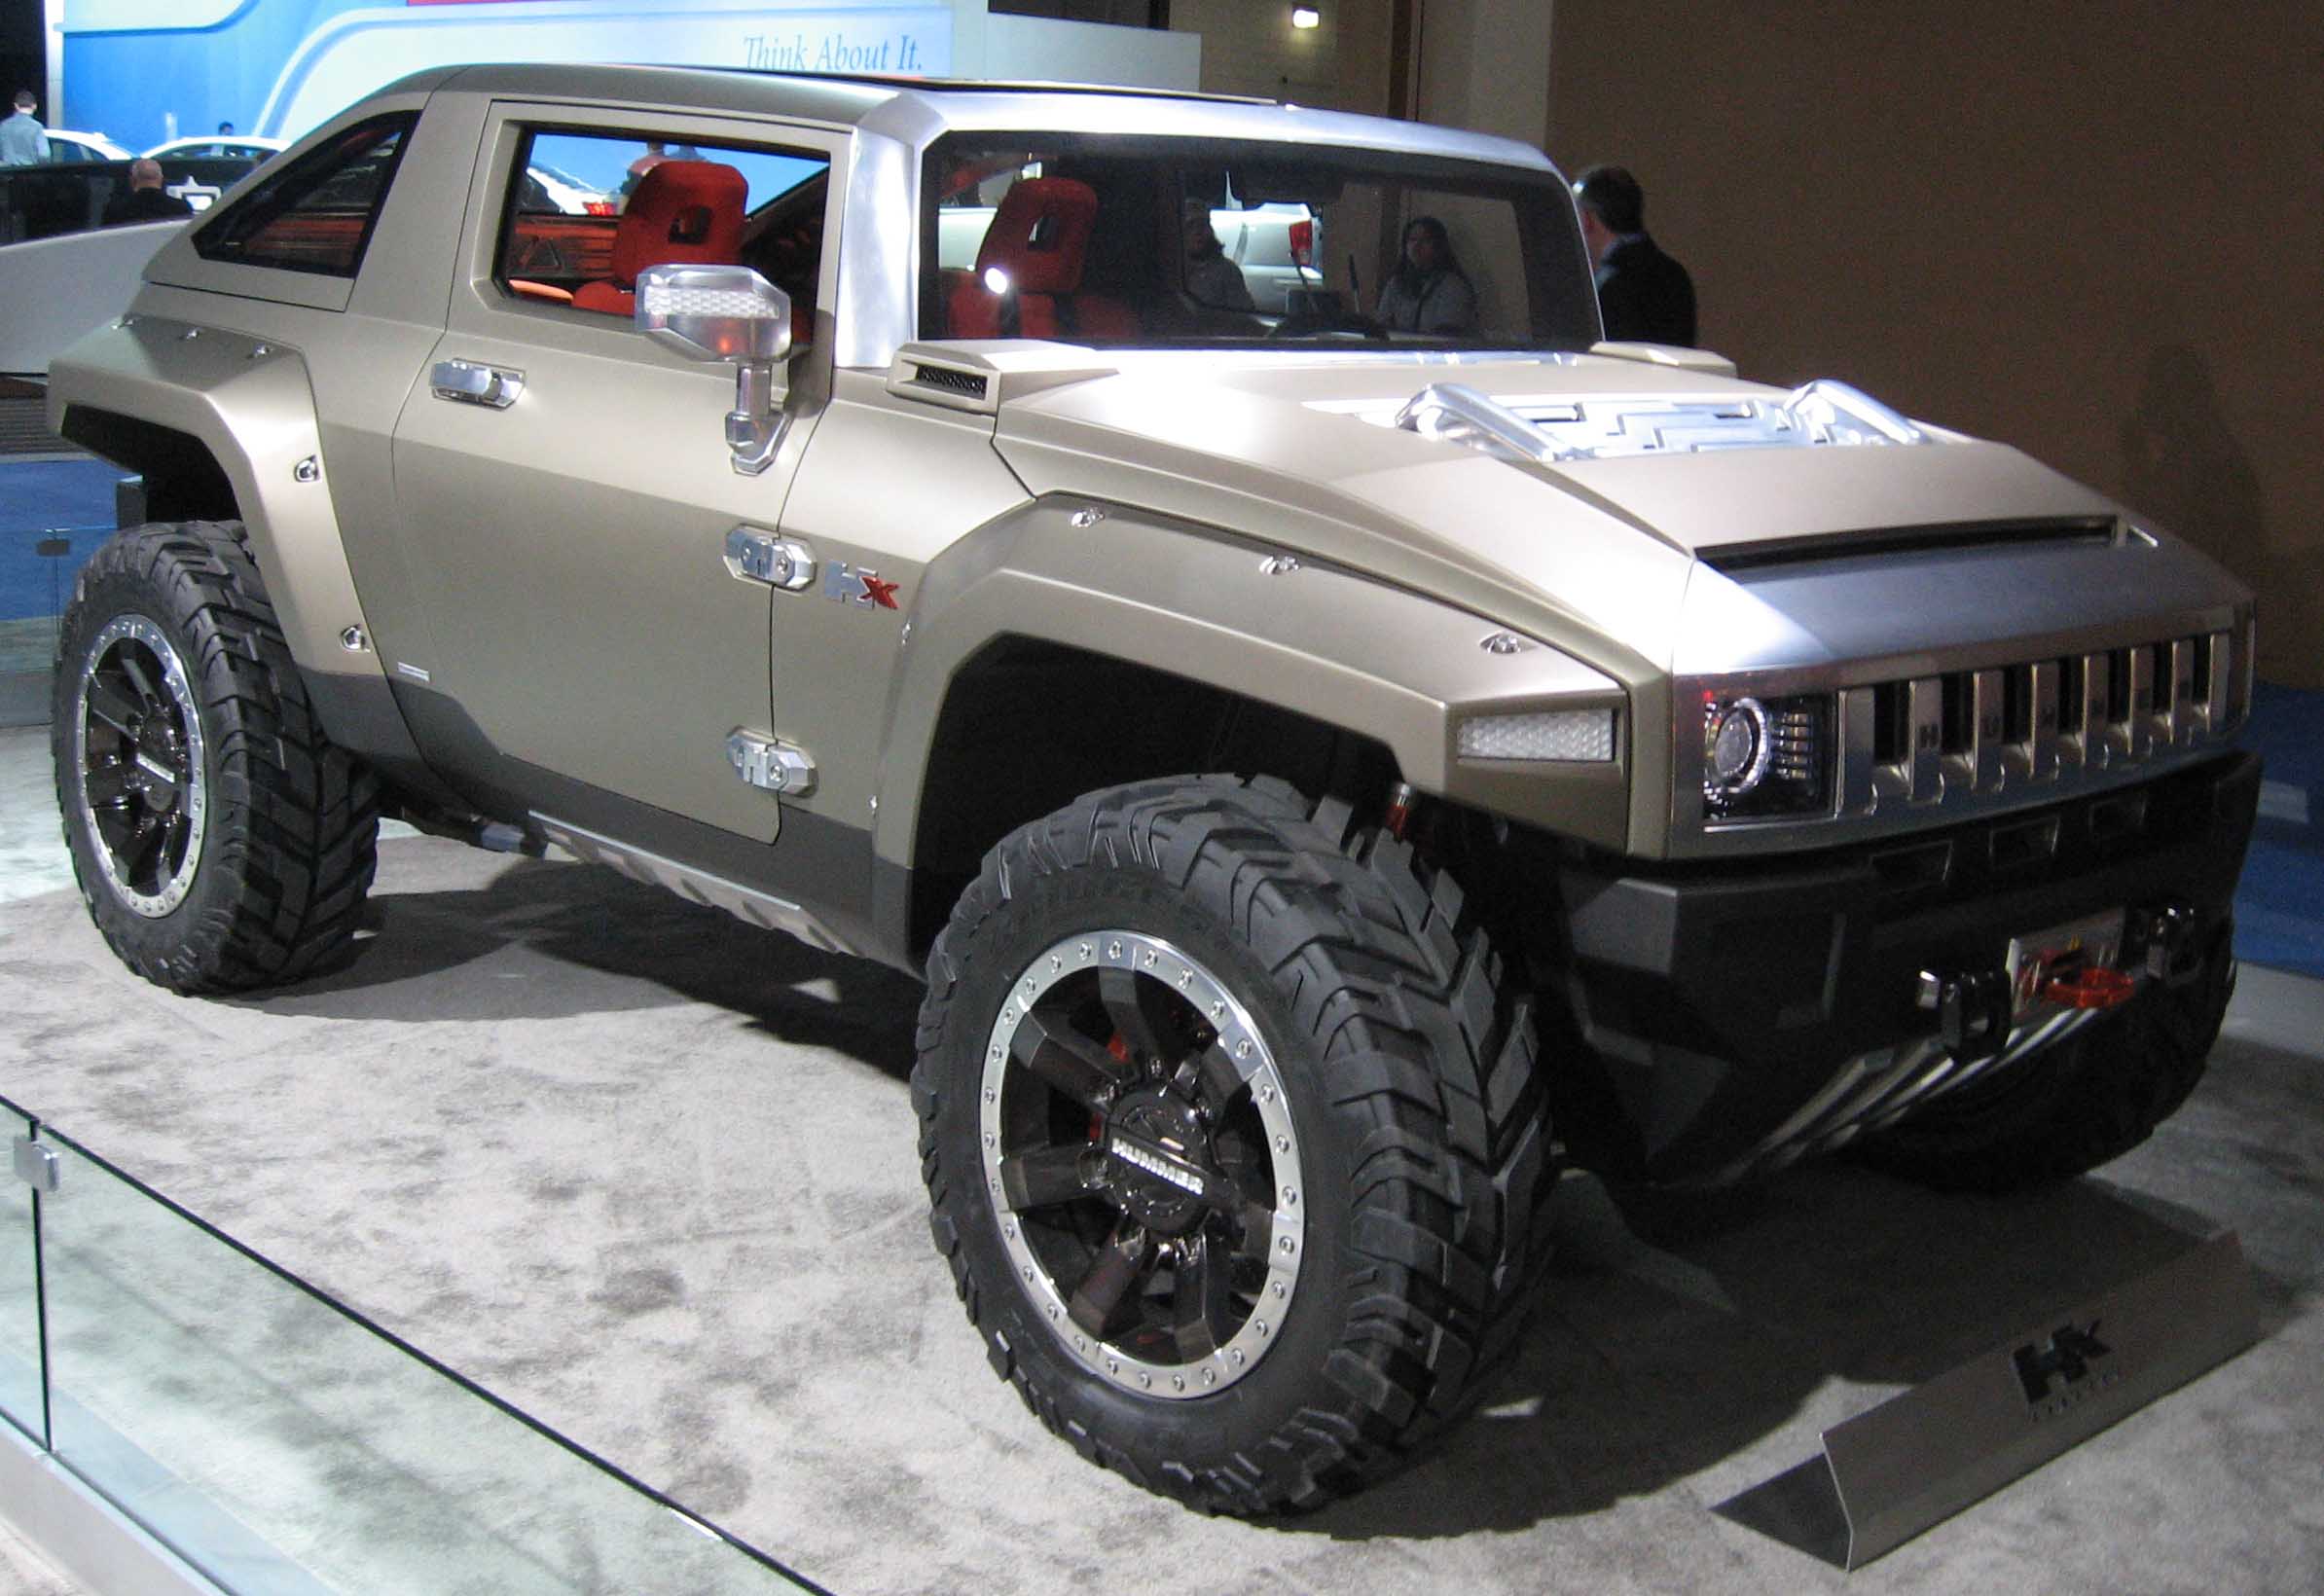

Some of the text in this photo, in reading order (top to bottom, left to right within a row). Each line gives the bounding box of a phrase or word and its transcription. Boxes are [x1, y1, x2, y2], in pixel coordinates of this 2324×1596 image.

[744, 33, 922, 71] Think About It.
